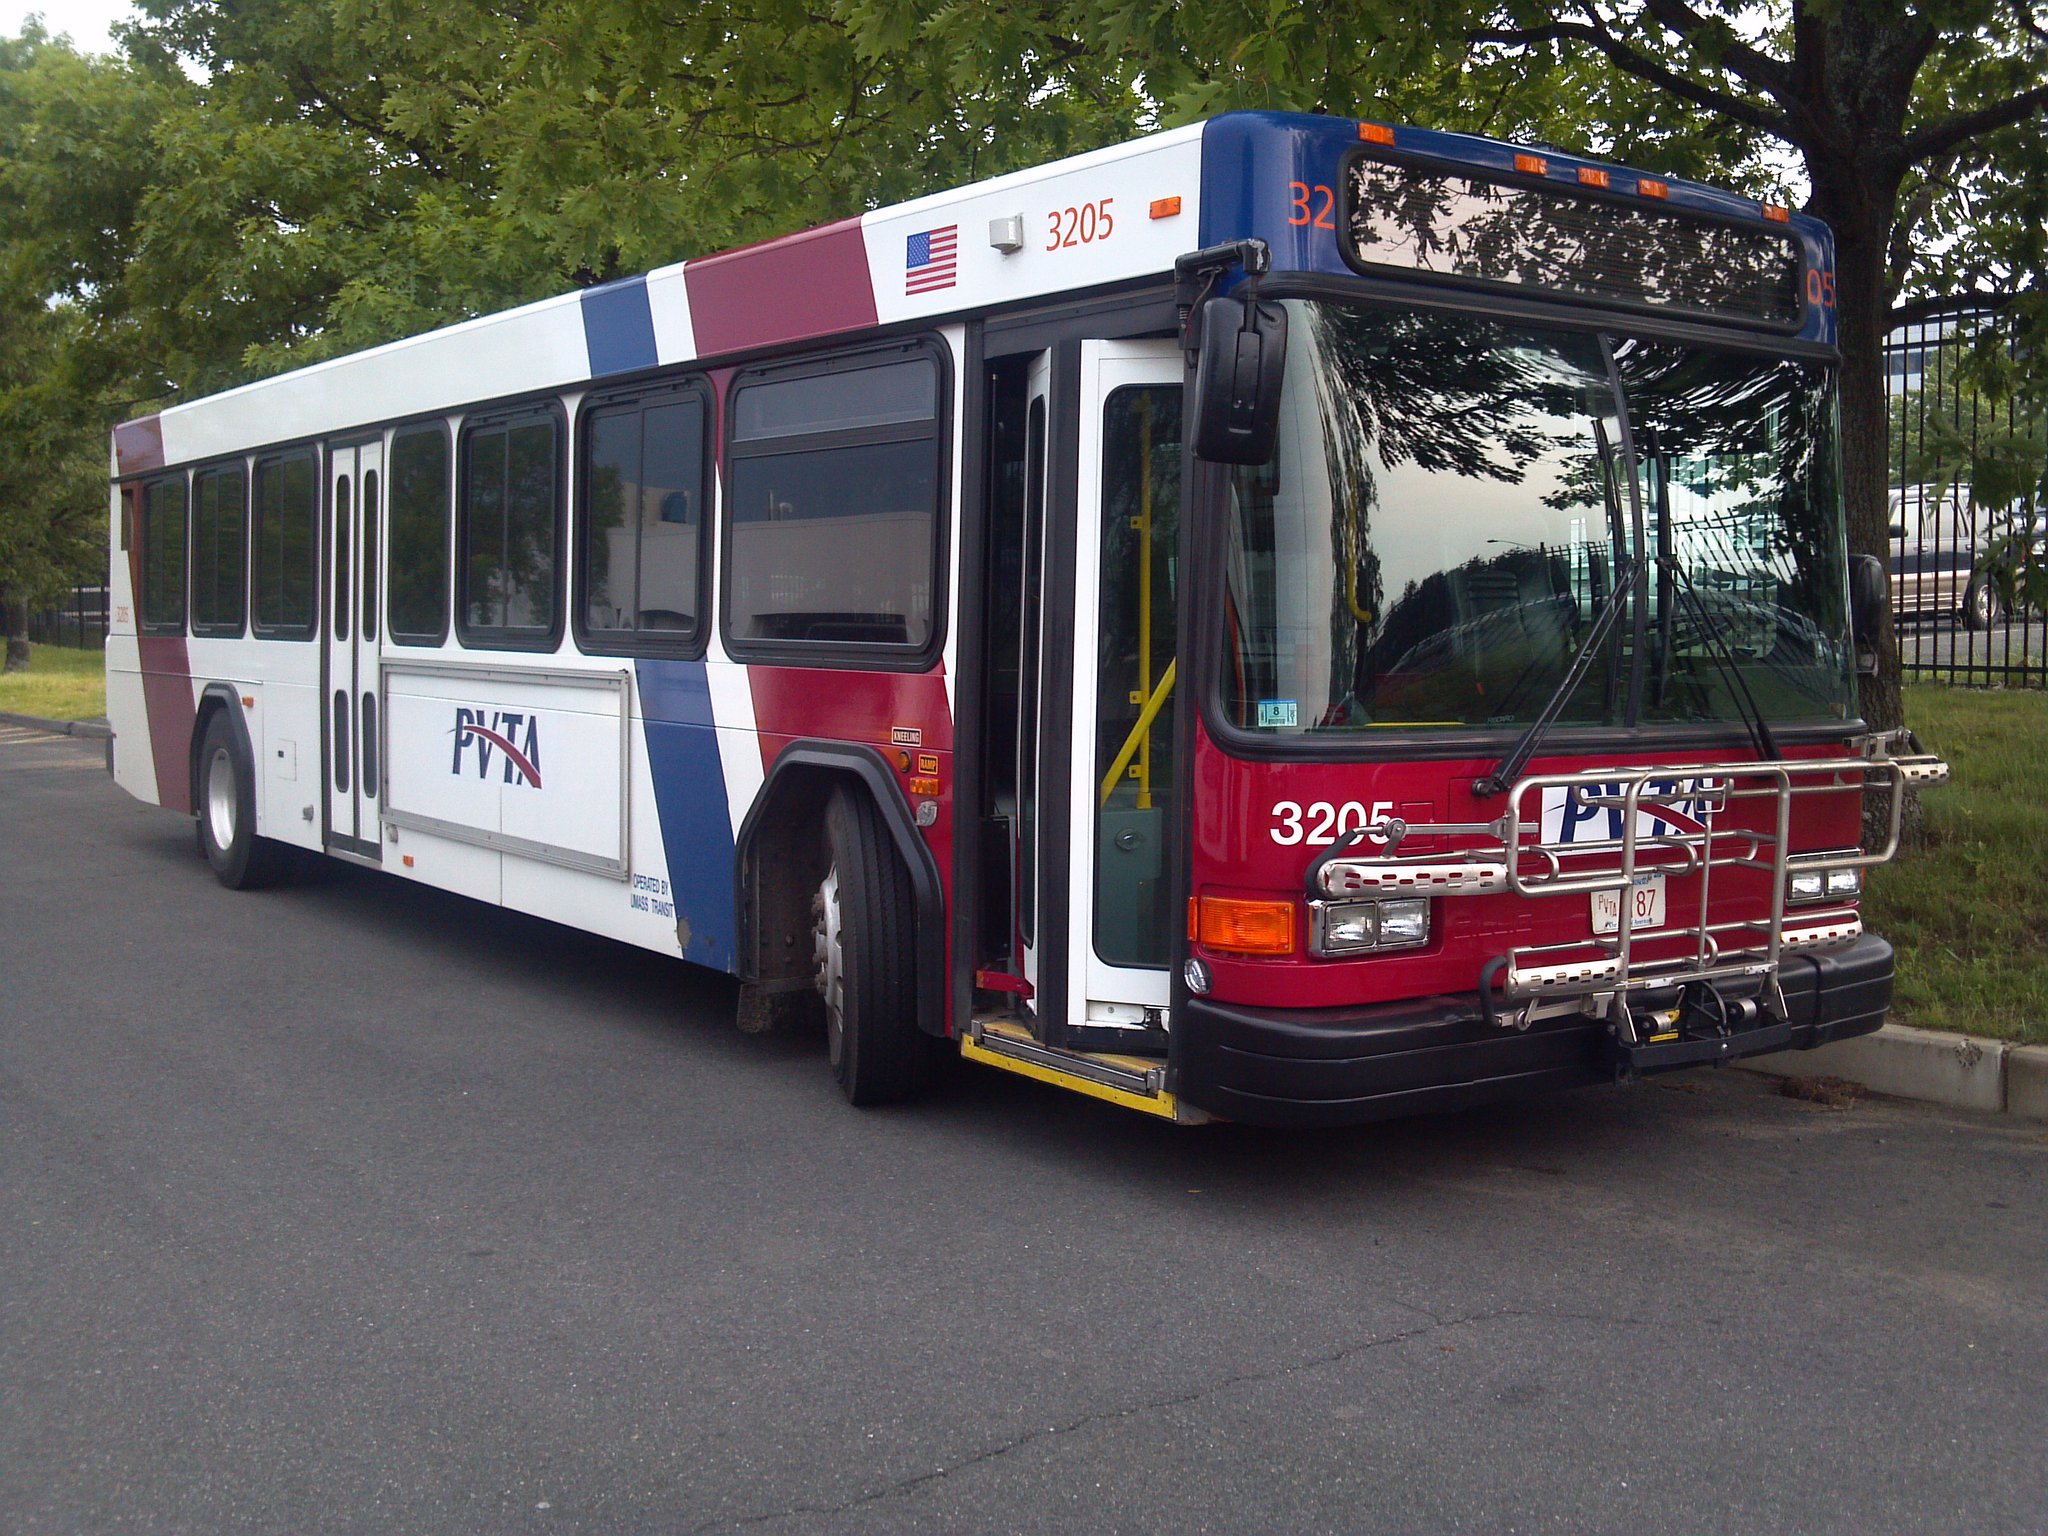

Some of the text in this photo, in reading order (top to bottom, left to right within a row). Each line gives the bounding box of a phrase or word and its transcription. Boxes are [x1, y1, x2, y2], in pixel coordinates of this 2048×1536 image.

[1046, 198, 1113, 251] 3205
[1288, 181, 1835, 308] 32 05
[1273, 706, 1280, 716] 8
[452, 707, 542, 789] PVTA
[893, 731, 920, 744] KNEELING
[920, 758, 937, 771] RAMP
[1269, 801, 1394, 846] 3205
[633, 872, 669, 896] OPERATED BY
[630, 893, 674, 918] UMASS TRANSIT
